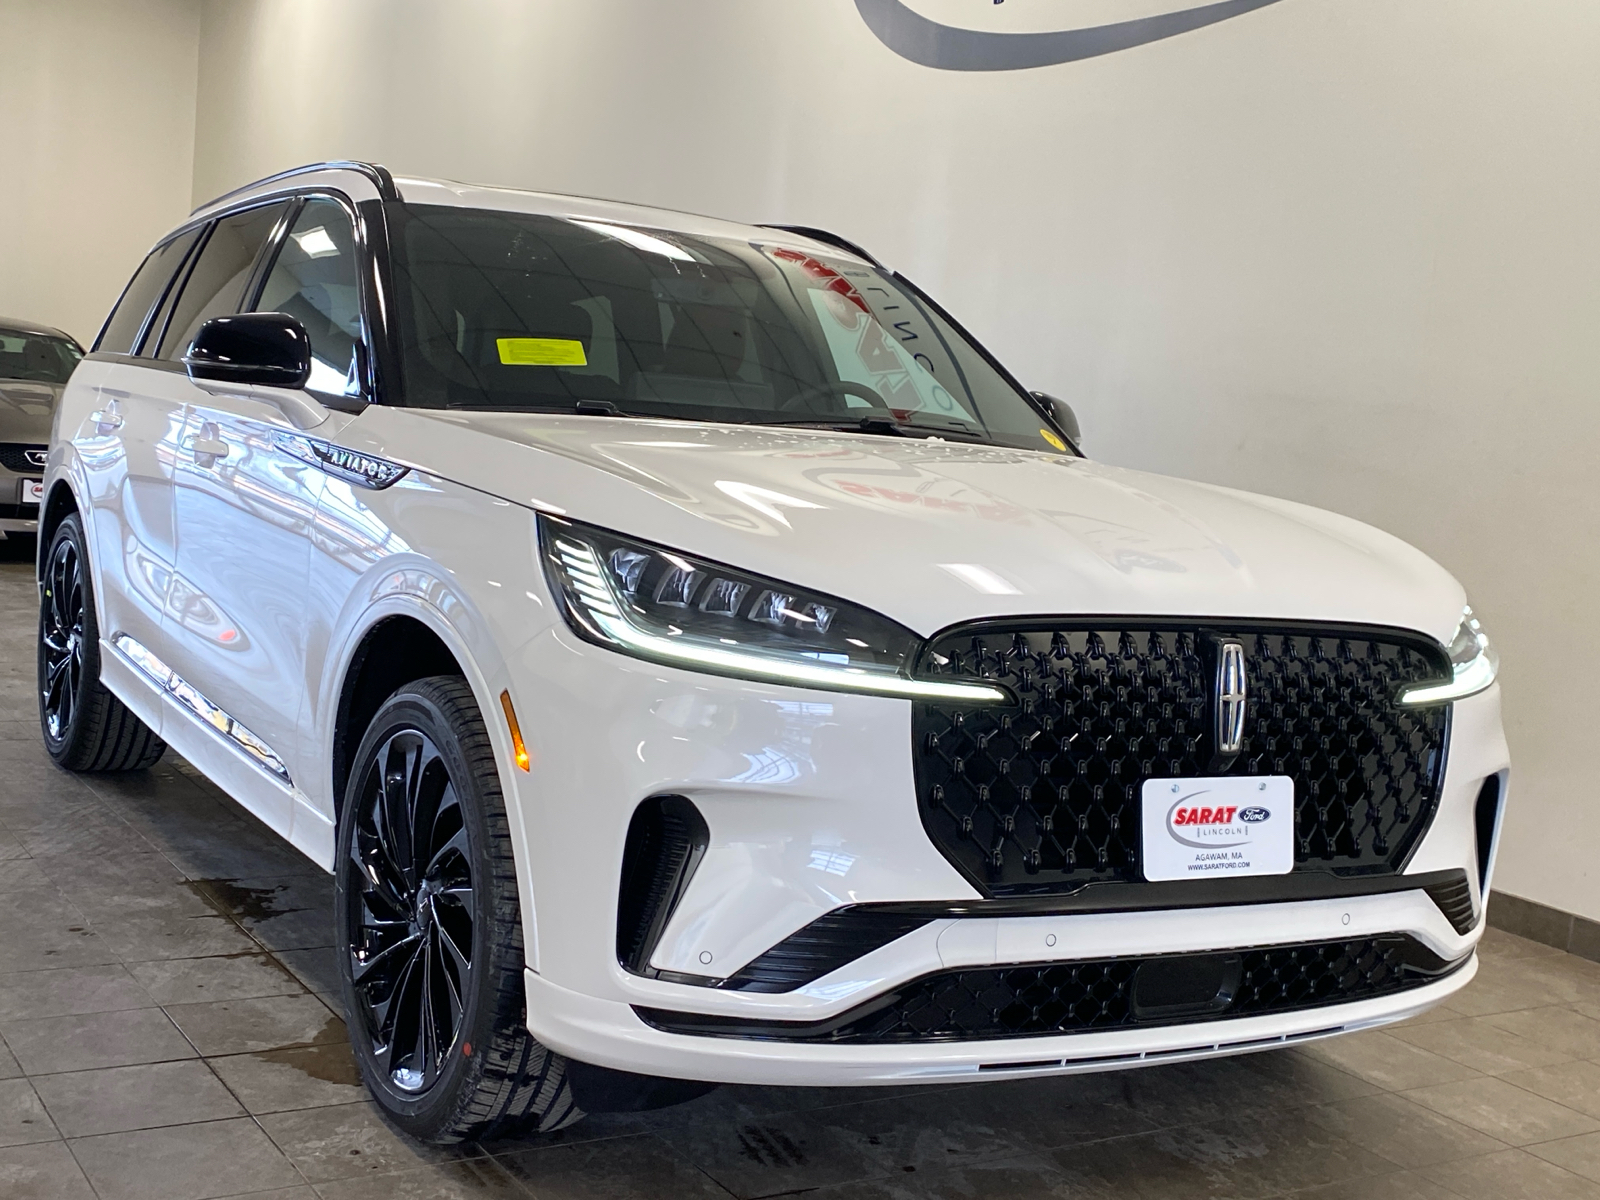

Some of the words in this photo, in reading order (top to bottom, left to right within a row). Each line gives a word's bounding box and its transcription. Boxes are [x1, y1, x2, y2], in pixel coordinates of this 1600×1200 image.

[330, 451, 387, 479] AVIATOR
[1174, 806, 1238, 825] SARAT
[1203, 828, 1242, 836] LINCOLN
[1195, 853, 1230, 862] AGAWAM,
[1231, 852, 1243, 860] MA
[1188, 862, 1250, 870] WWW.SARATFORD.COM
